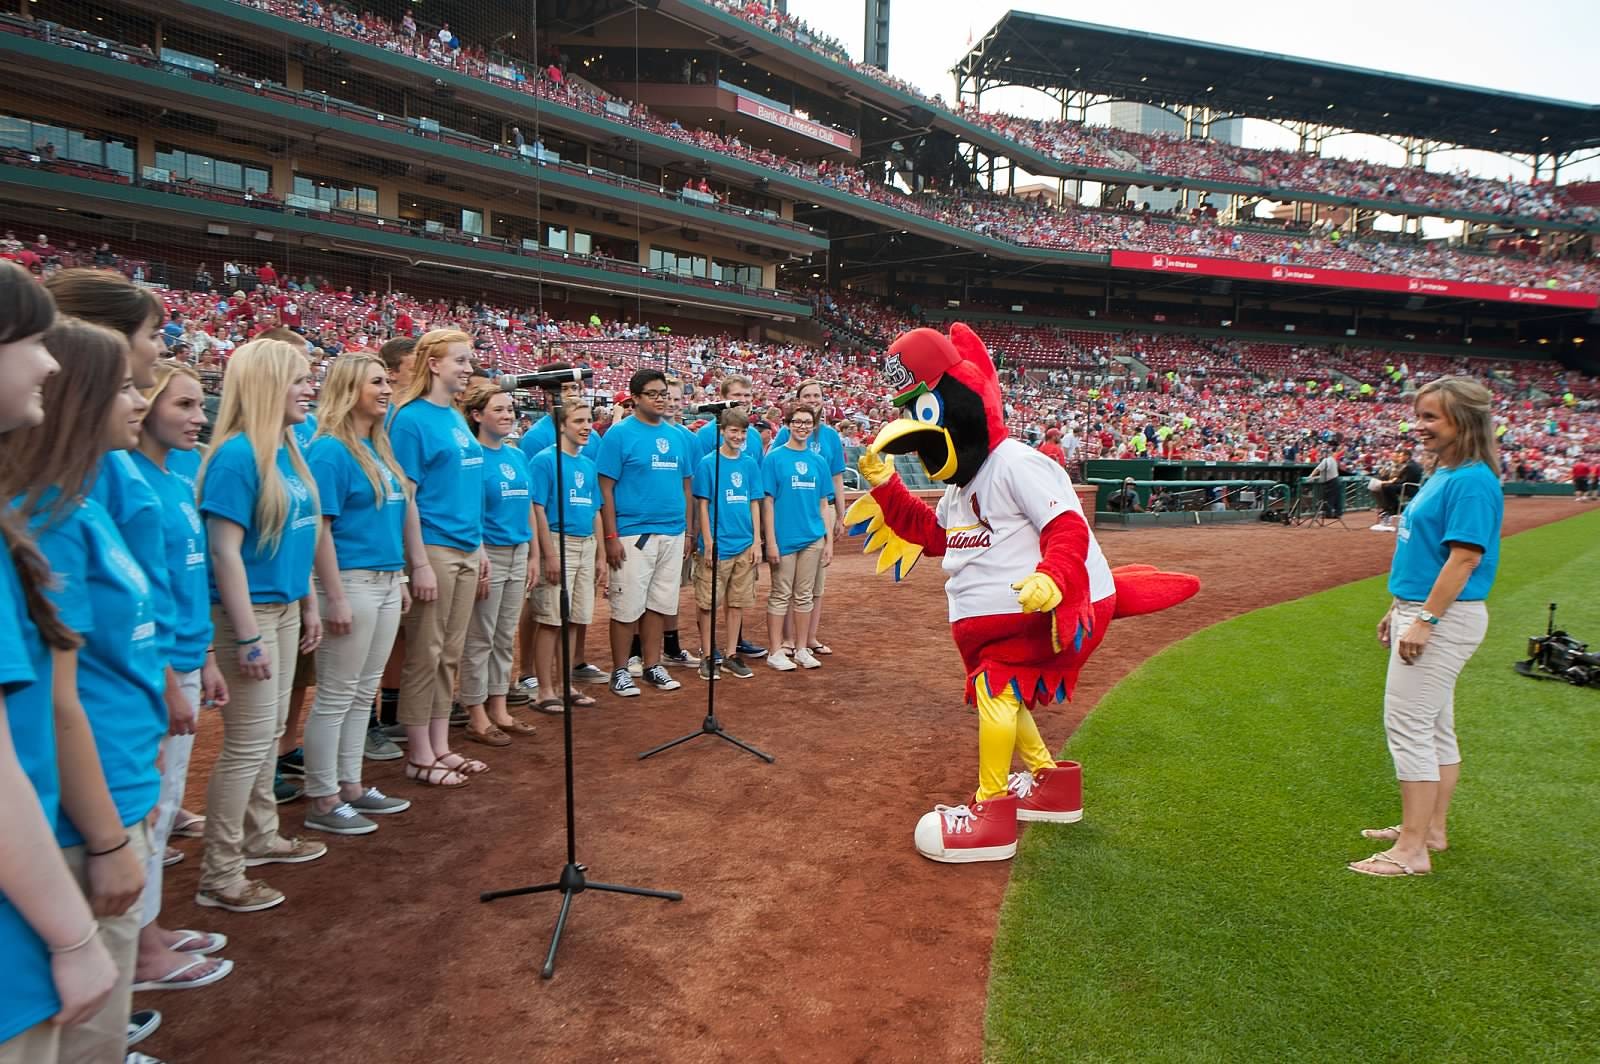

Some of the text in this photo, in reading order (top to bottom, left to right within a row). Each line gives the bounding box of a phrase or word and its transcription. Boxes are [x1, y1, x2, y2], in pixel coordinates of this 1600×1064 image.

[758, 106, 834, 142] Bank of America Club
